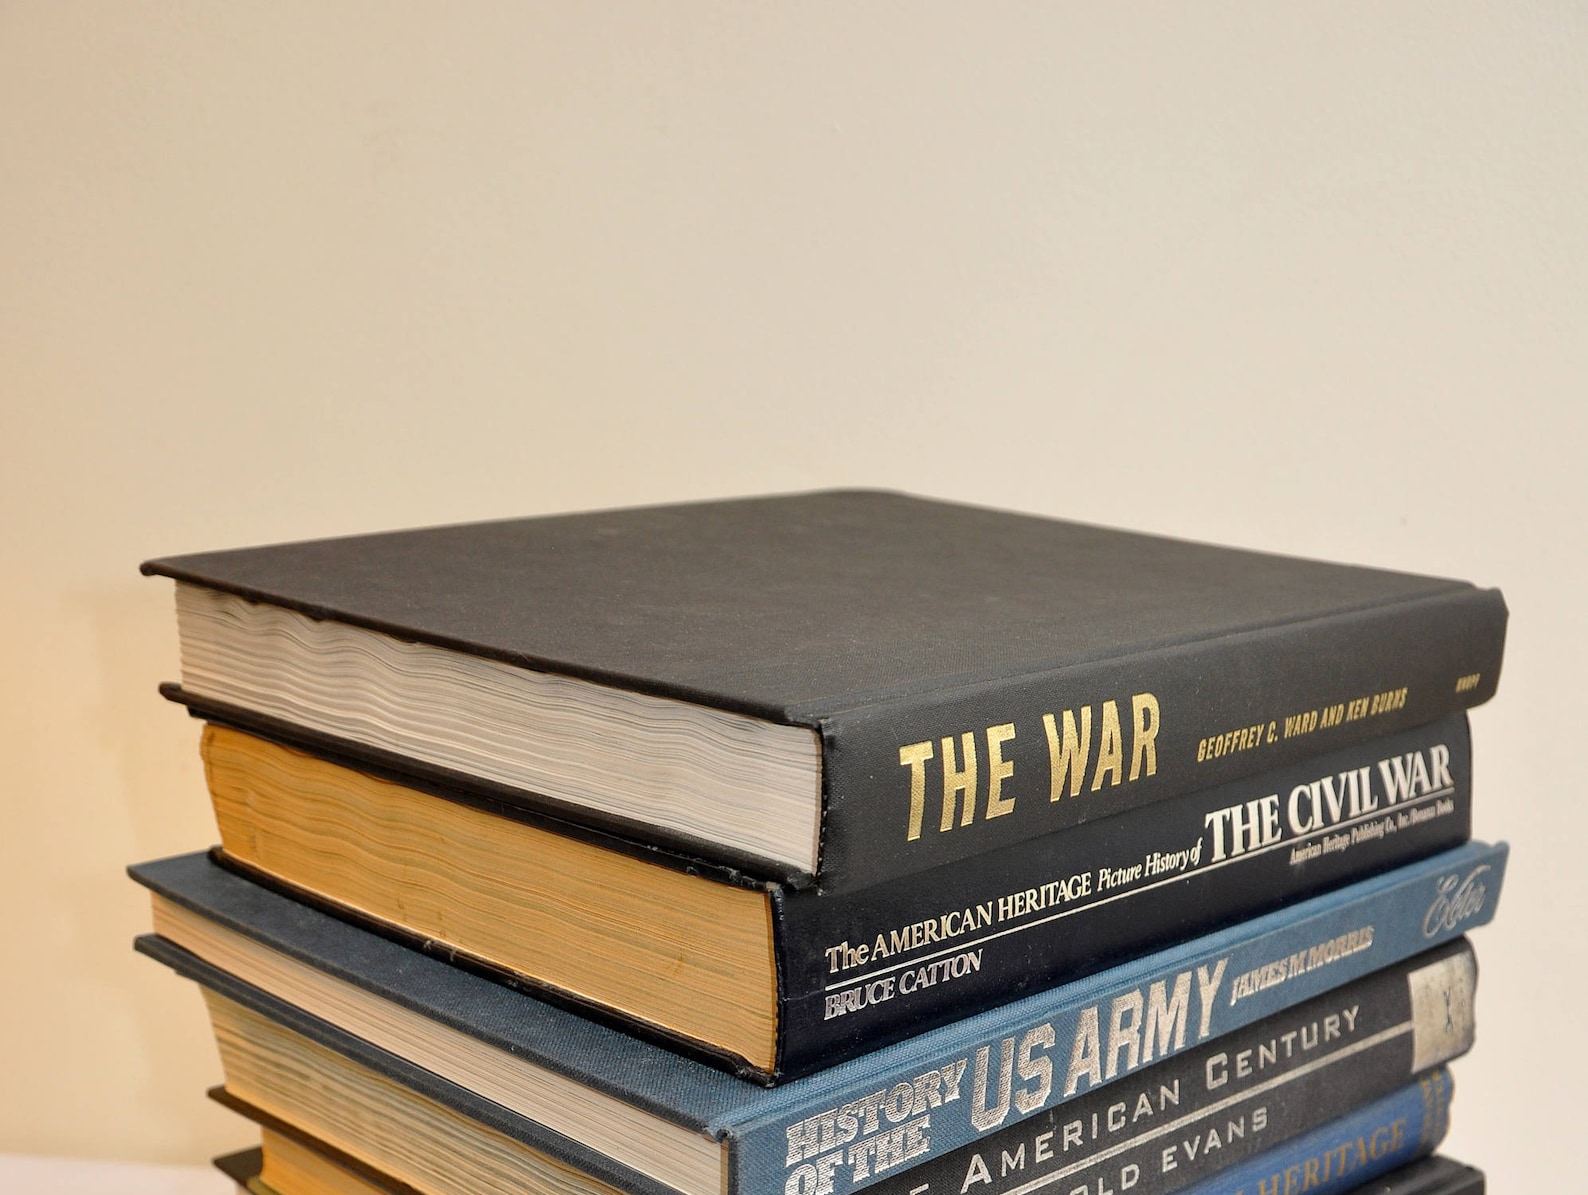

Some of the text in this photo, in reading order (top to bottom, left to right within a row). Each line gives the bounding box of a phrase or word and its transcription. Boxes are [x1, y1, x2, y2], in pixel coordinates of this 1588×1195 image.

[900, 693, 1160, 841] THE WAR
[1197, 687, 1408, 762] GEOFFREY C. WARD AND KEN BURNS
[825, 744, 1454, 973] The AMERICAN HERITAGE Picture History of THE CIVIL WAR
[823, 948, 984, 1021] BRUCE CATTON
[1229, 925, 1375, 1008] JAMES M MORRIS
[971, 956, 1229, 1132] US ARMY
[785, 1058, 968, 1167] HISTORY
[960, 1079, 1181, 1195] AMERICAN
[1206, 1005, 1359, 1091] CENTURY
[1162, 1106, 1268, 1173] EVANS
[843, 1120, 931, 1183] THE
